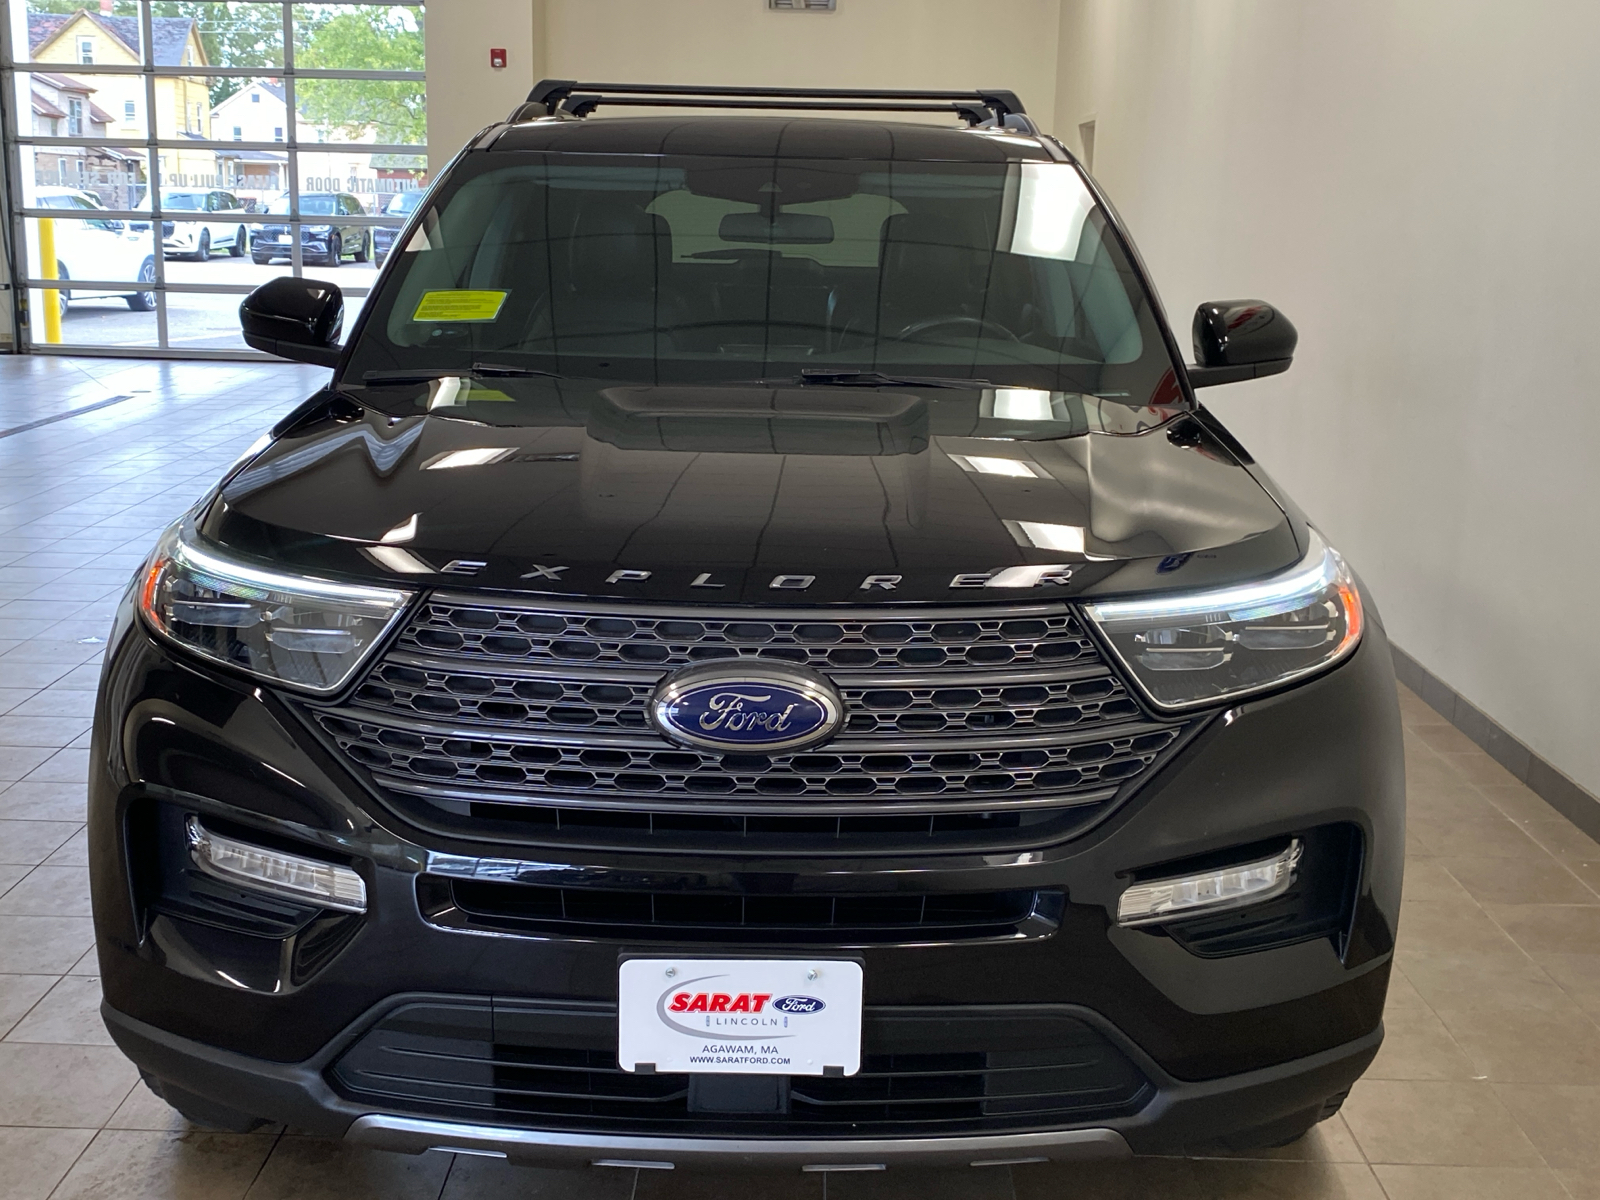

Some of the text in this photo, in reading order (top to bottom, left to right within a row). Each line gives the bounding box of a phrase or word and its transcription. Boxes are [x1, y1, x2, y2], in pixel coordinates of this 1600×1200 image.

[440, 559, 1074, 591] EXPLORER
[699, 692, 799, 732] Ford
[668, 992, 816, 1014] SARAT Ford
[716, 1017, 778, 1026] LINCOLN
[702, 1045, 779, 1055] AGAWAM, MA
[690, 1056, 791, 1065] WWW.SARATFORD.COM
